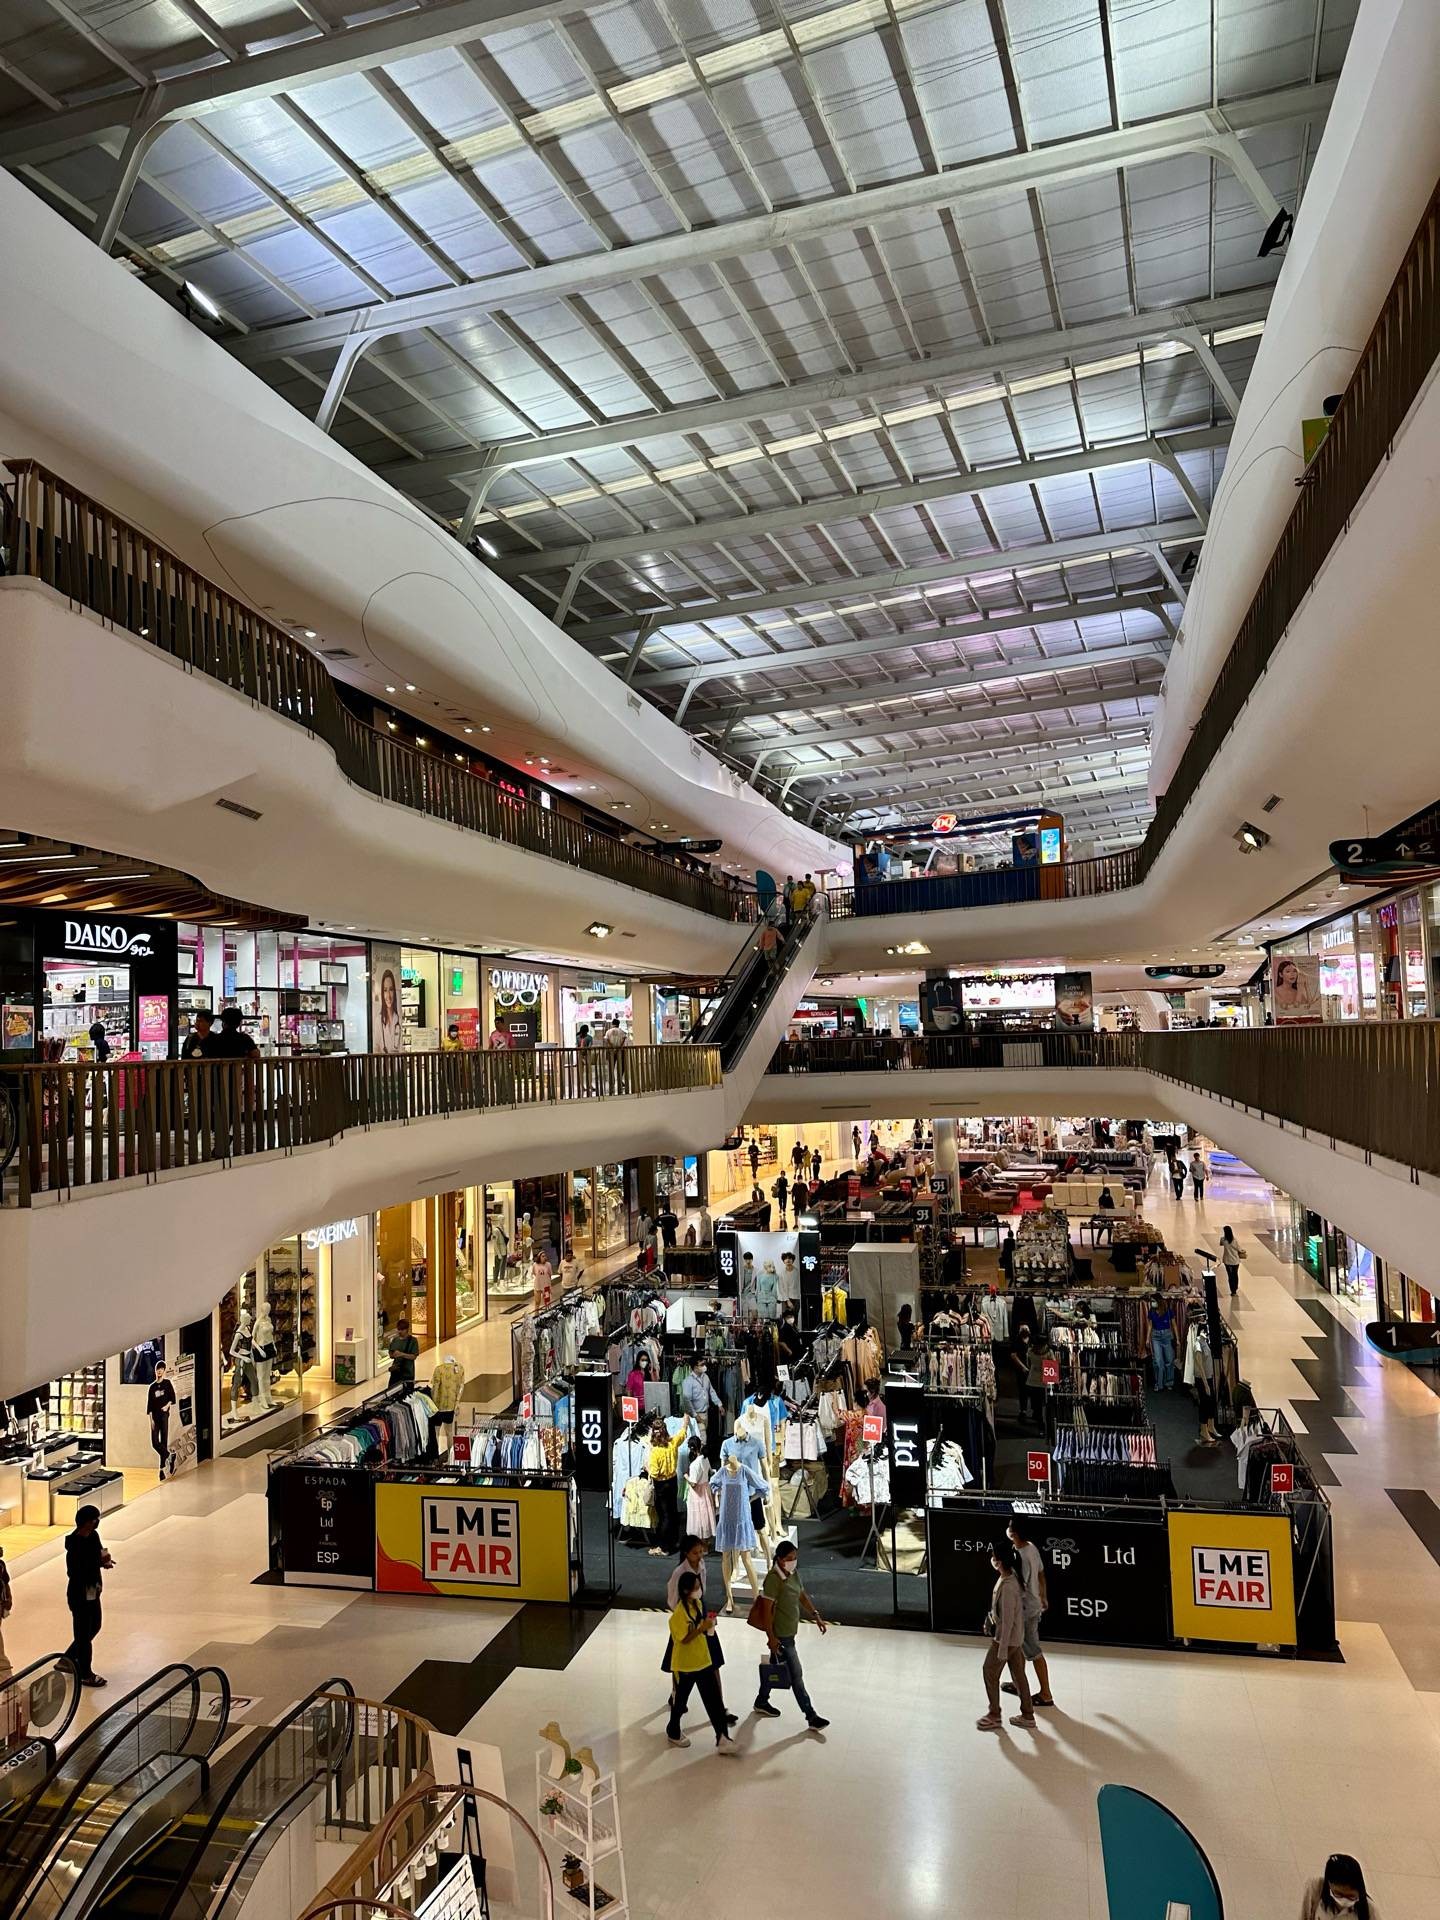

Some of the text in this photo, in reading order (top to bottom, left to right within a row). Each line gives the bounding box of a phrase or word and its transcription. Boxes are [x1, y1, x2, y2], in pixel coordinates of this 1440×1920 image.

[1347, 843, 1362, 863] 2
[64, 921, 128, 949] DAISO
[491, 968, 549, 992] OWNDAYS
[306, 1219, 359, 1250] SABINA
[720, 1250, 733, 1276] ESP
[1386, 1326, 1397, 1347] 1
[582, 1410, 602, 1455] ESP
[893, 1422, 920, 1468] Ltd
[320, 1517, 334, 1528] Ltd
[317, 1551, 340, 1564] ESP
[430, 1541, 512, 1576] FAIR
[1052, 1549, 1071, 1569] Ep
[1102, 1545, 1136, 1565] Ltd
[1199, 1578, 1265, 1603] FAIR
[1067, 1597, 1109, 1618] ESP
